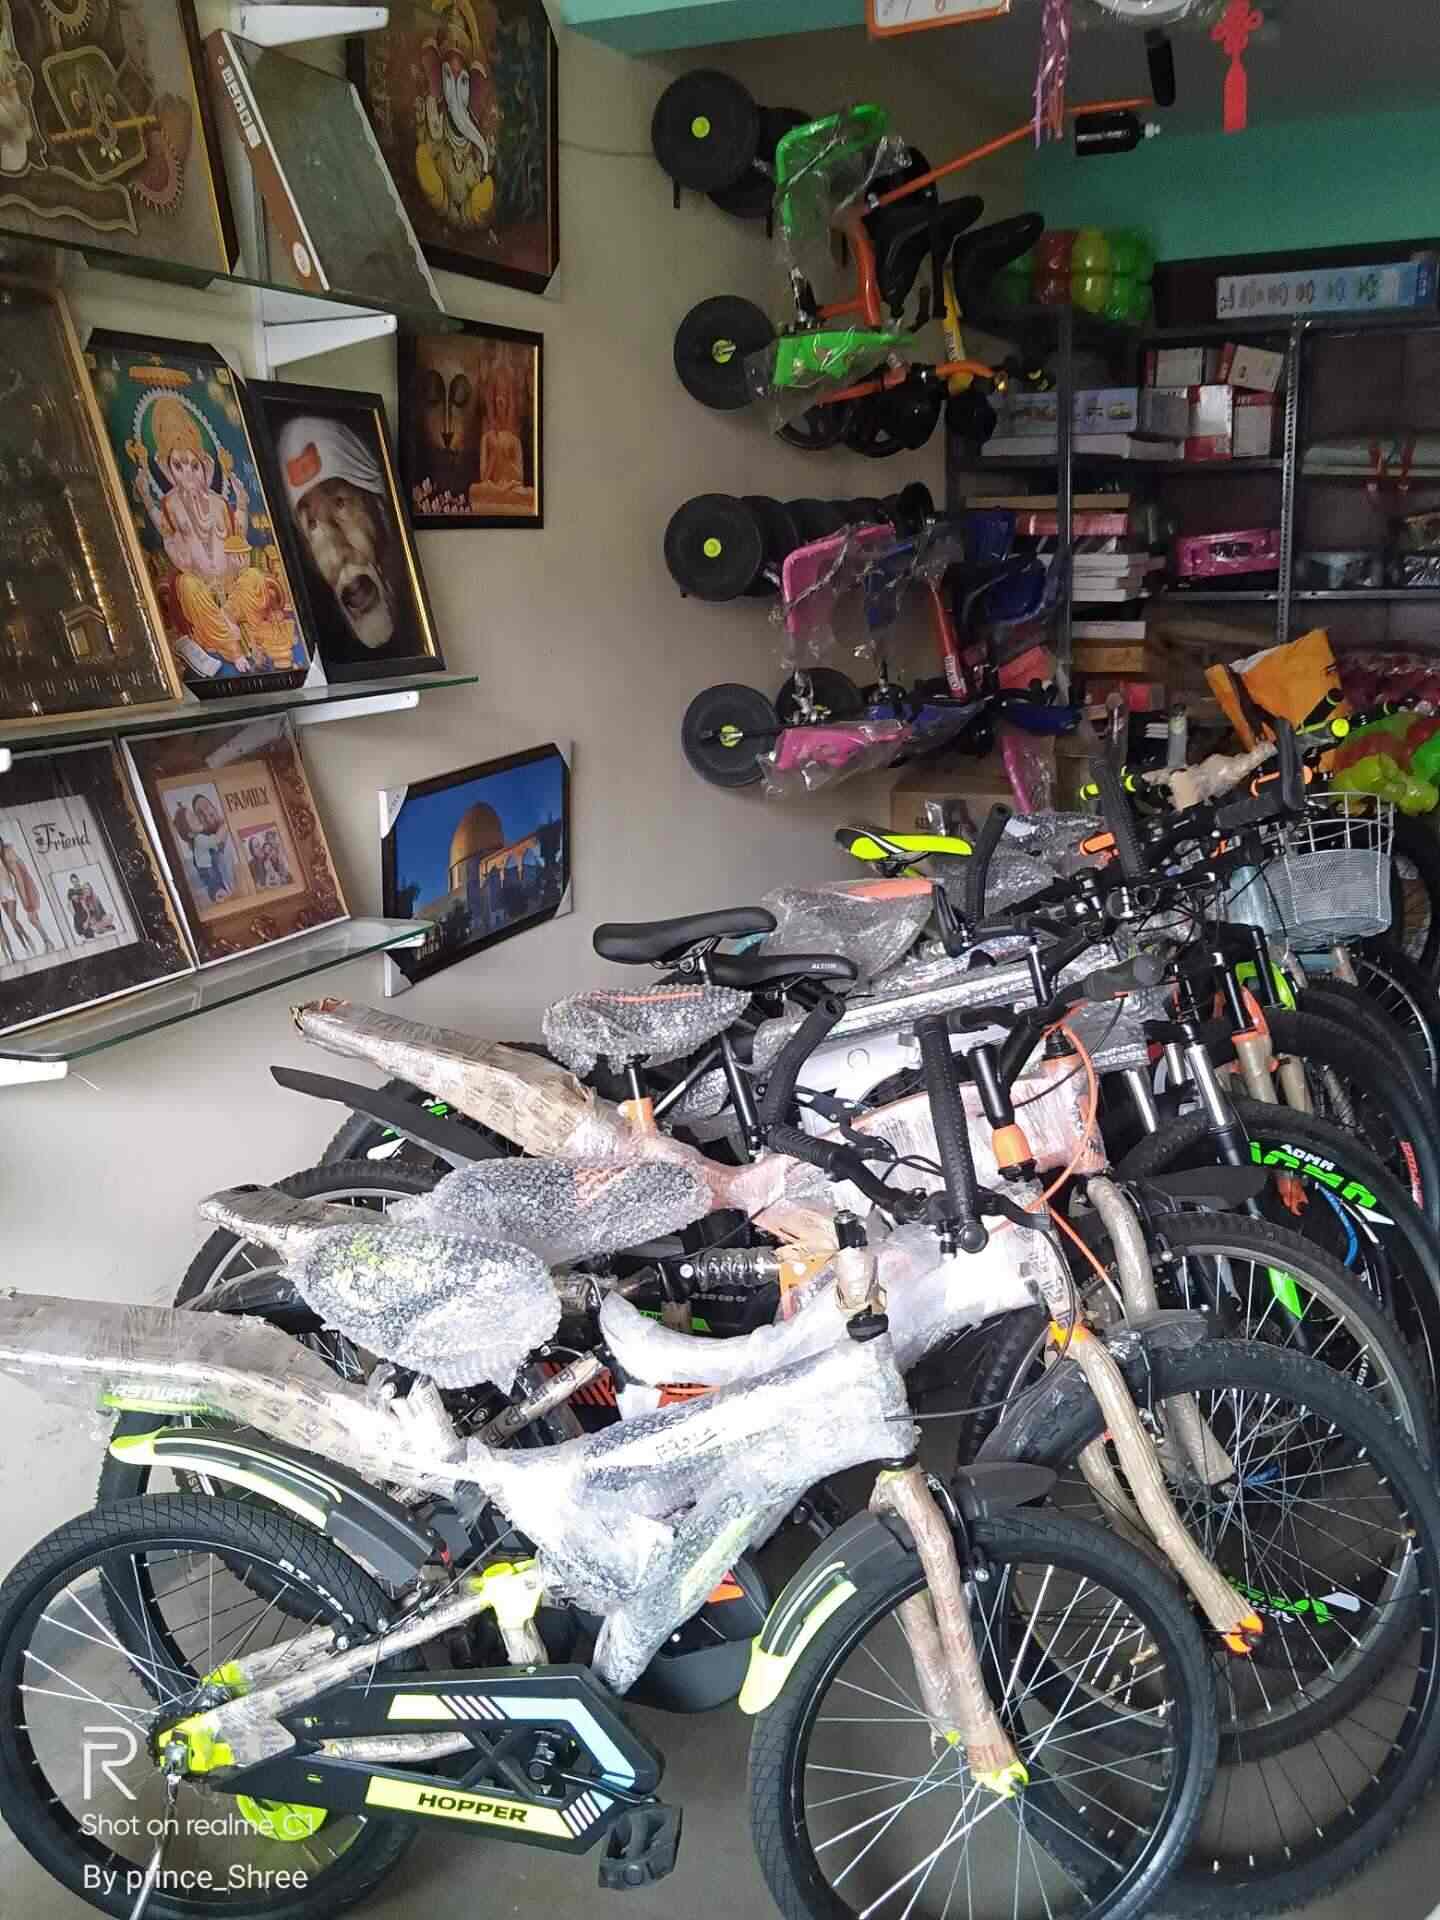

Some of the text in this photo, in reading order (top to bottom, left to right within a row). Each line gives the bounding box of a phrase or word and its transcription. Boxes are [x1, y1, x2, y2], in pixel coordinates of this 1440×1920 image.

[225, 786, 270, 812] FAMILY
[32, 820, 92, 855] Friend
[418, 1792, 528, 1823] HOPPER
